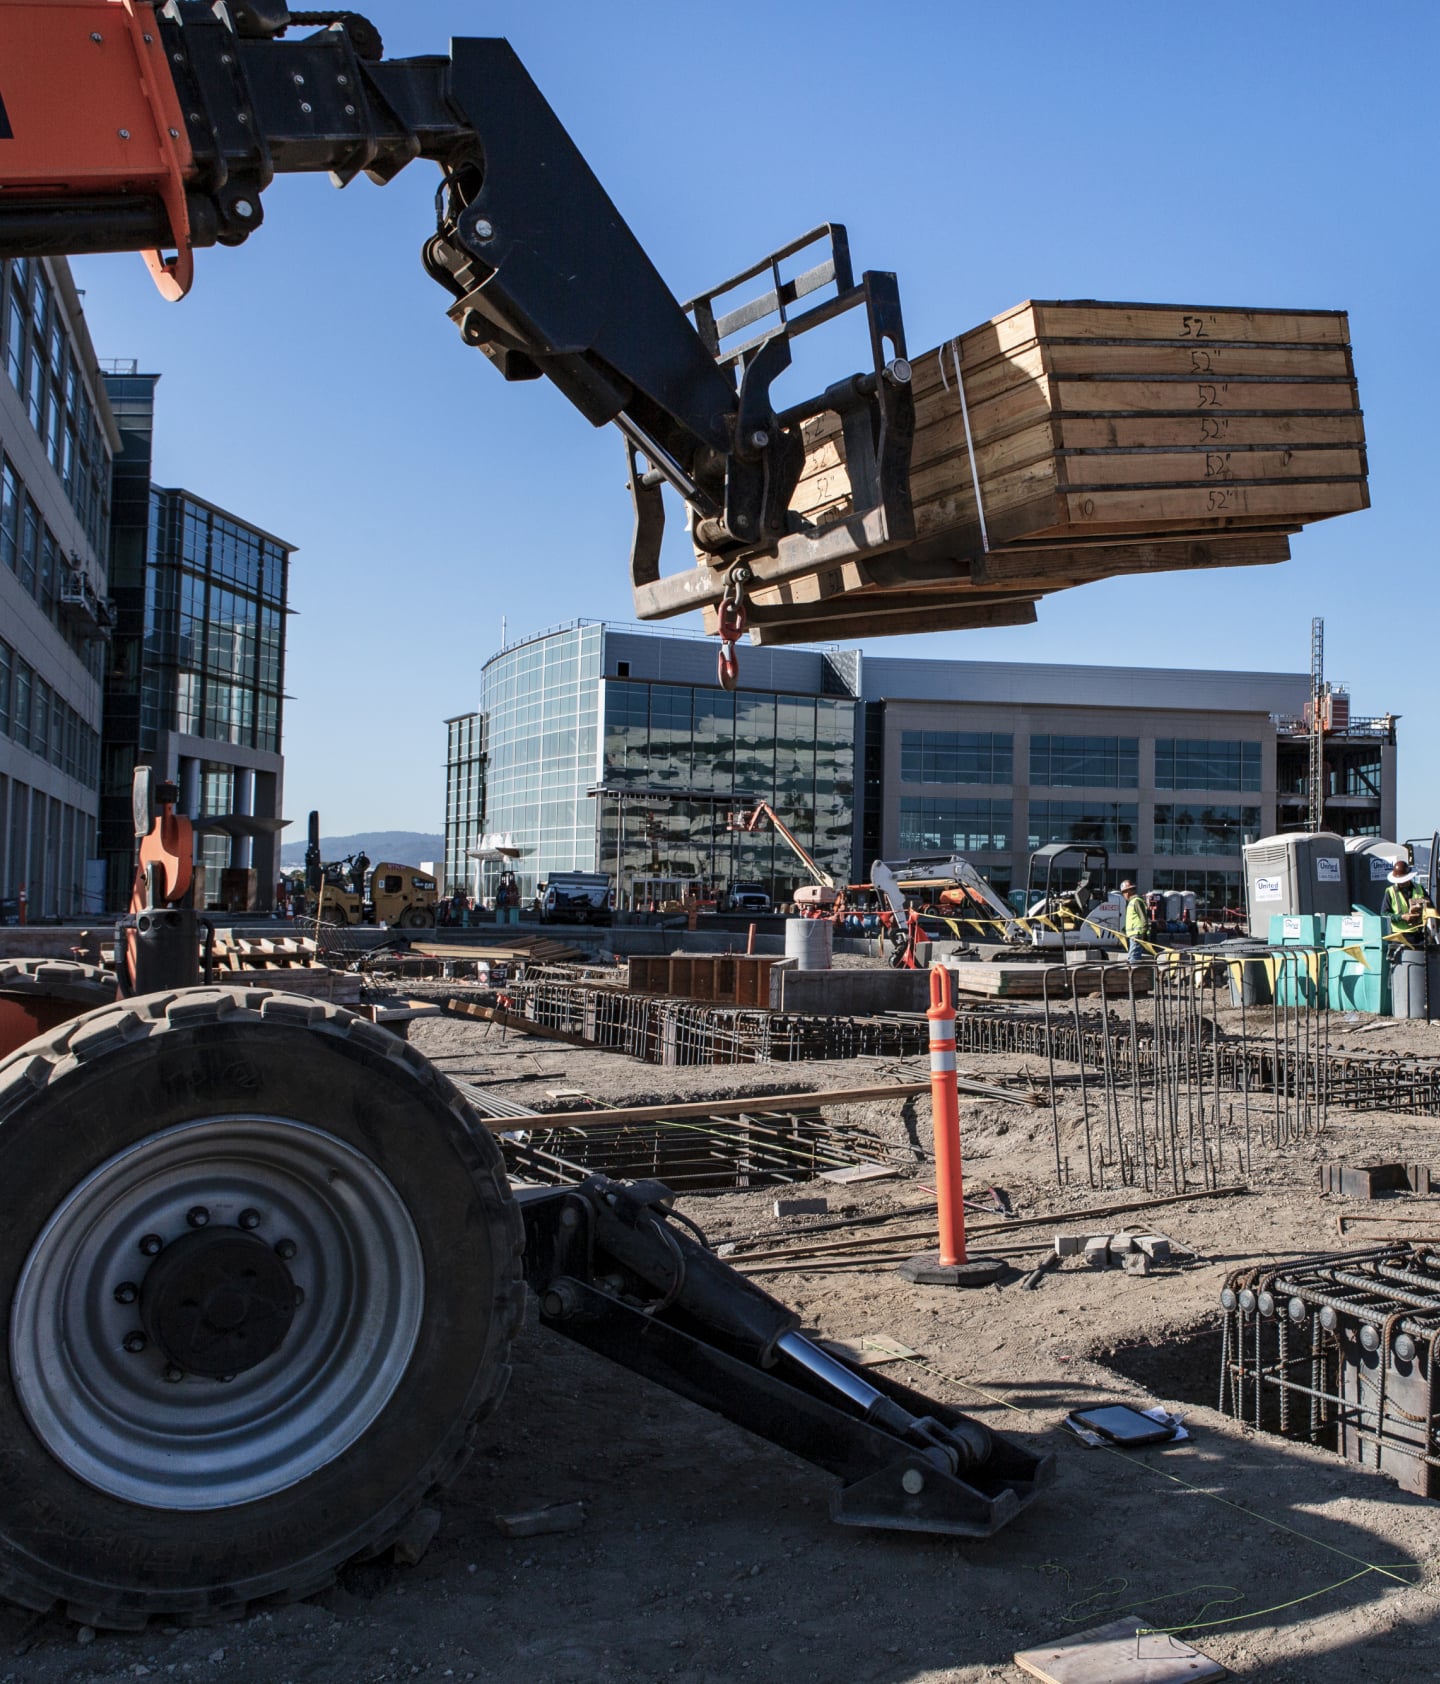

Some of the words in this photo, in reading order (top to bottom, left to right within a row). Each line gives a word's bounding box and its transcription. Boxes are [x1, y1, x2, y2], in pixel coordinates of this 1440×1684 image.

[1179, 315, 1217, 337] 52"
[1190, 350, 1221, 374] 52"
[1197, 384, 1228, 408] 52"
[1200, 418, 1229, 442] 52"
[1204, 453, 1231, 477] 52"
[816, 475, 835, 505] 52"
[1207, 489, 1233, 512] 52"
[1258, 881, 1279, 890] United
